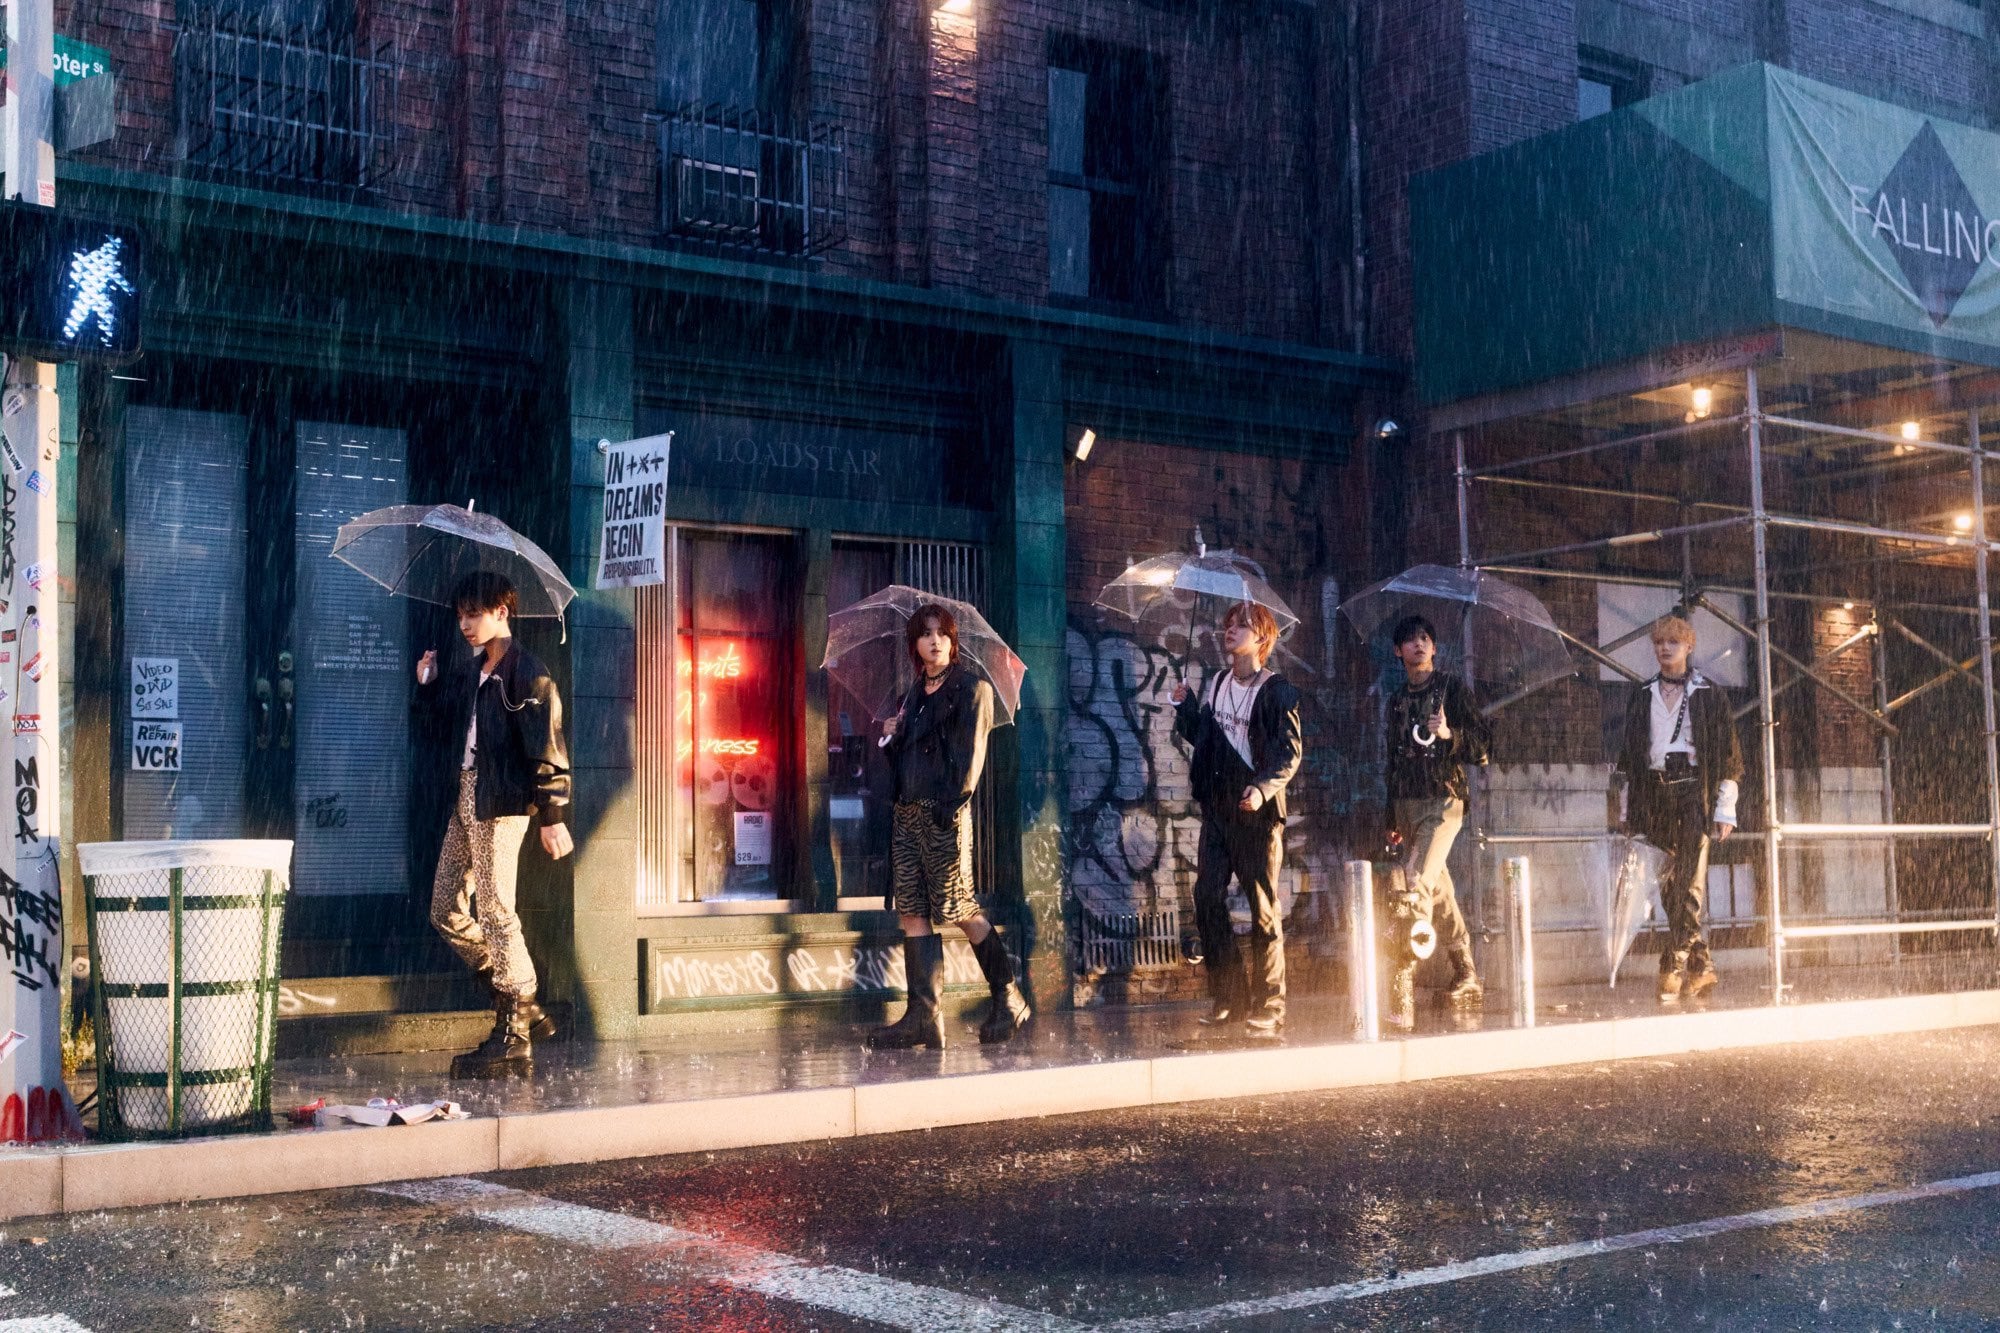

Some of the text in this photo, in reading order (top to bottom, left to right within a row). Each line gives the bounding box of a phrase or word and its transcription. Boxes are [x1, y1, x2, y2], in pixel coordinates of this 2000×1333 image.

[93, 61, 104, 75] St
[715, 436, 881, 476] LOADSTAR
[607, 451, 625, 485] IN
[605, 482, 663, 522] DREAMS
[137, 725, 178, 741] REPAIR
[148, 724, 162, 732] WE
[135, 745, 179, 768] VCR
